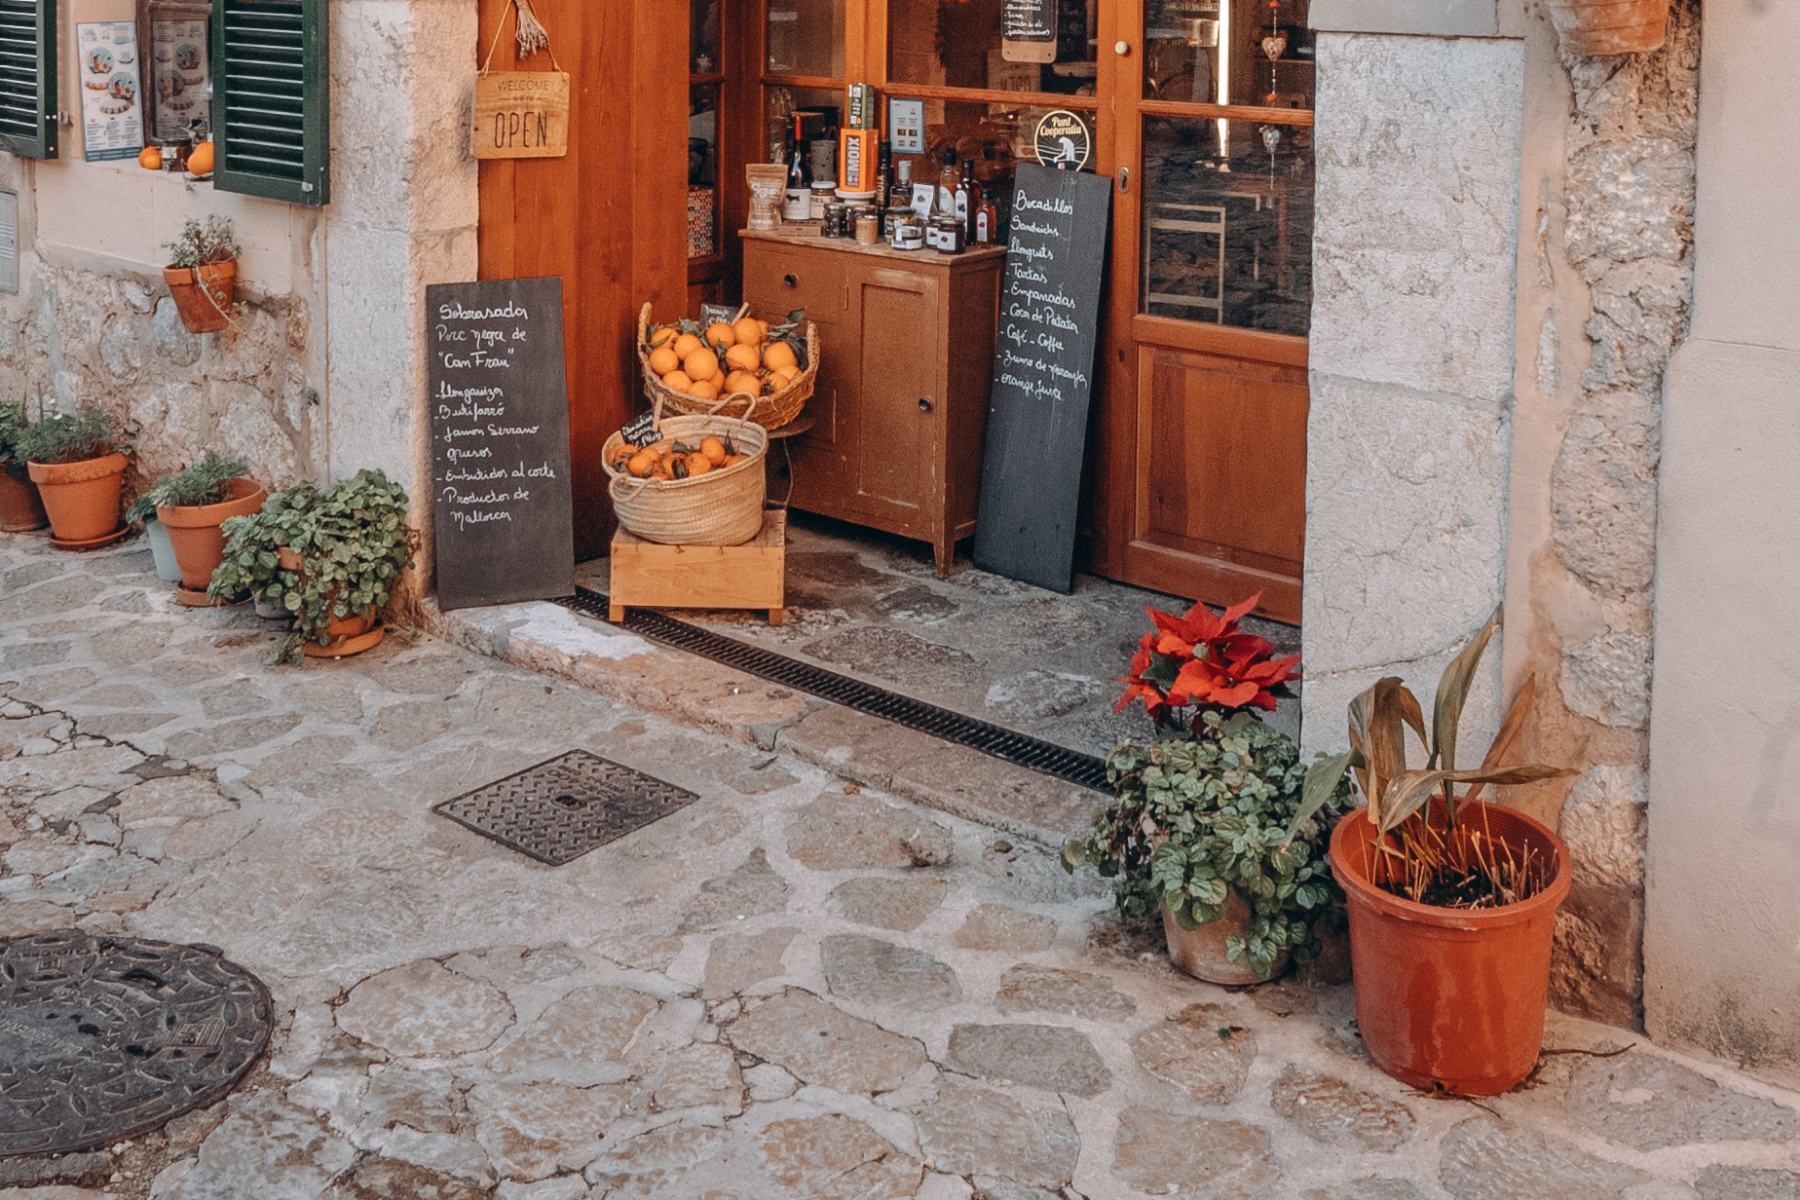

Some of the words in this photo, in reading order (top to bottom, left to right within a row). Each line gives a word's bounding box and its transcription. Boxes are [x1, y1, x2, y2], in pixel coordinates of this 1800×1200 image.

[497, 79, 550, 91] WELCOME
[494, 111, 548, 149] OPEN
[1015, 189, 1073, 215] Bocadillos
[1010, 262, 1048, 284] Tartas
[1011, 281, 1076, 309] Empanadas
[439, 300, 529, 320] Sobrasada
[1032, 307, 1043, 323] de
[435, 323, 468, 342] Porc
[512, 327, 528, 342] de
[1035, 358, 1047, 372] de
[487, 423, 540, 436] Serrano
[445, 467, 508, 481] Embutidos
[511, 460, 526, 478] al
[528, 461, 556, 479] corte
[443, 486, 511, 505] Productos
[513, 486, 530, 501] de
[449, 510, 512, 532] Mallorca
